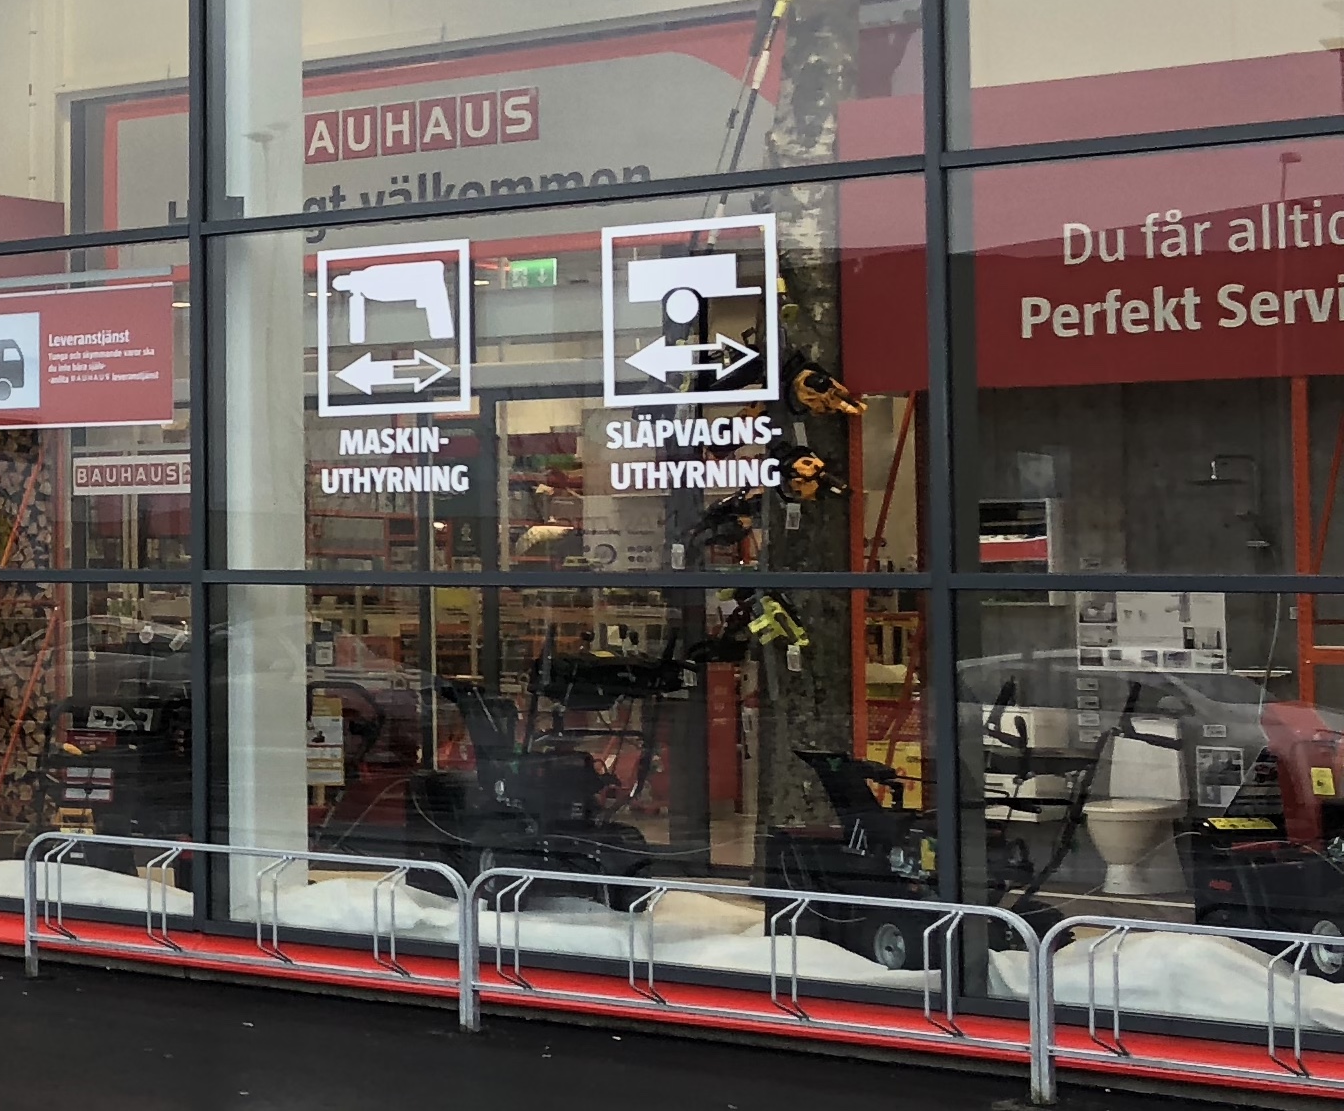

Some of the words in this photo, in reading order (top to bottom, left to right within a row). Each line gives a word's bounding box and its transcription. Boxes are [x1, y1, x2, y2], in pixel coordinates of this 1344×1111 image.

[308, 94, 532, 157] AUHAUS
[1063, 222, 1126, 266] Du
[1140, 209, 1211, 260] får
[1021, 286, 1202, 339] Perfekt
[48, 329, 130, 348] Leveranstjänst
[339, 426, 450, 455] MASKIN-
[605, 414, 782, 449] SLÄPVAGNS-
[77, 465, 178, 484] BAUHAUS
[321, 464, 470, 494] UTHYRNING
[610, 457, 782, 490] UTHYRNING
